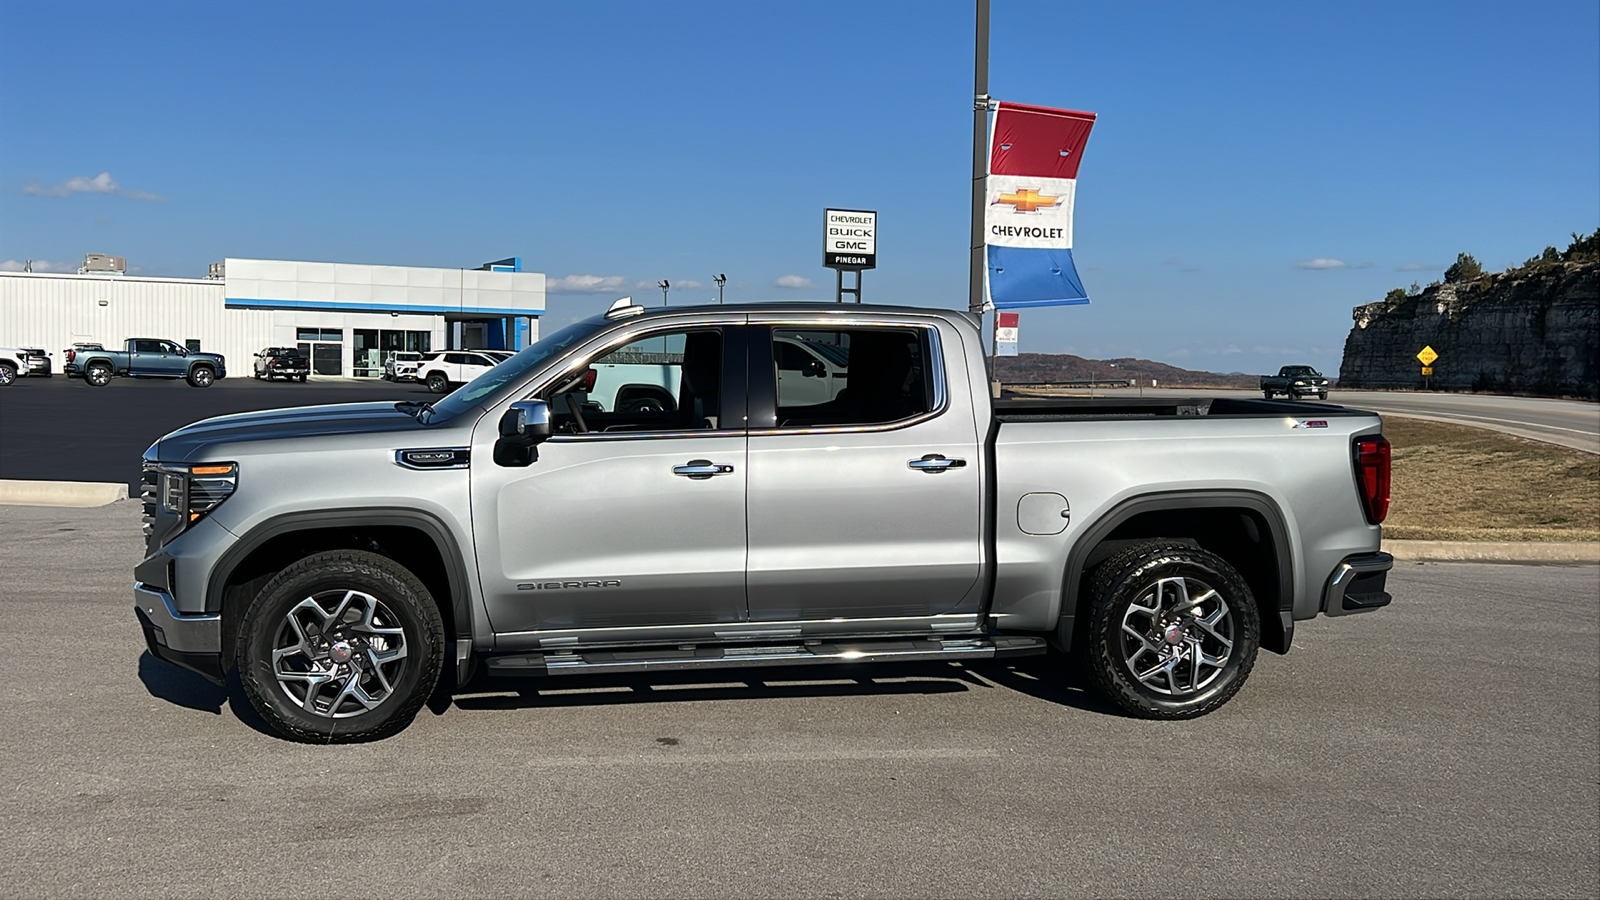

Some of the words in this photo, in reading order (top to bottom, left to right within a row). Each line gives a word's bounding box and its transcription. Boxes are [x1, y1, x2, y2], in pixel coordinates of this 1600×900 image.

[830, 215, 872, 224] CHEVROLET
[830, 228, 872, 238] BUICK
[991, 225, 1063, 239] CHEVROLET
[835, 241, 867, 250] GMC
[835, 256, 866, 264] PINEGAR
[516, 580, 621, 590] SIERRA
